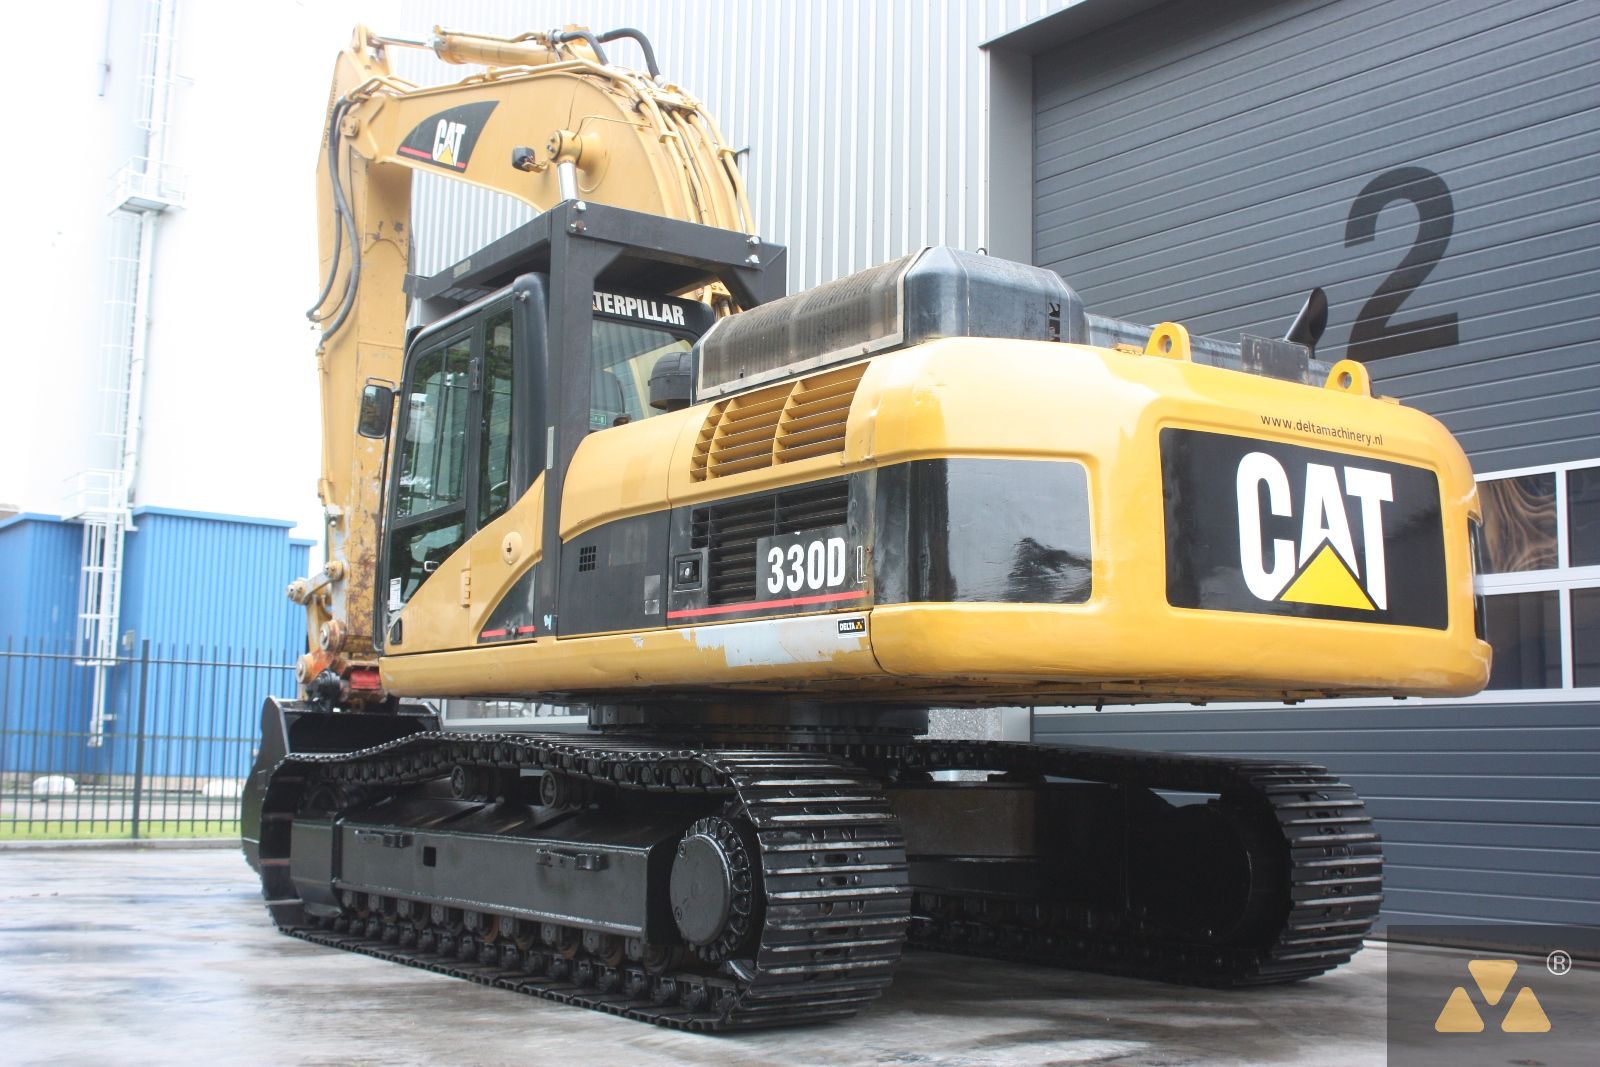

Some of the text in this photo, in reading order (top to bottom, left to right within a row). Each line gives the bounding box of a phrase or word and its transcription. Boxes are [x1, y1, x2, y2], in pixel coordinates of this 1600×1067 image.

[432, 118, 467, 167] CAT
[1344, 166, 1459, 363] 2
[1260, 415, 1383, 446] www.deltamachinery.nl
[1236, 451, 1394, 611] CAT
[767, 537, 846, 594] 330D
[839, 621, 856, 631] DELTA
